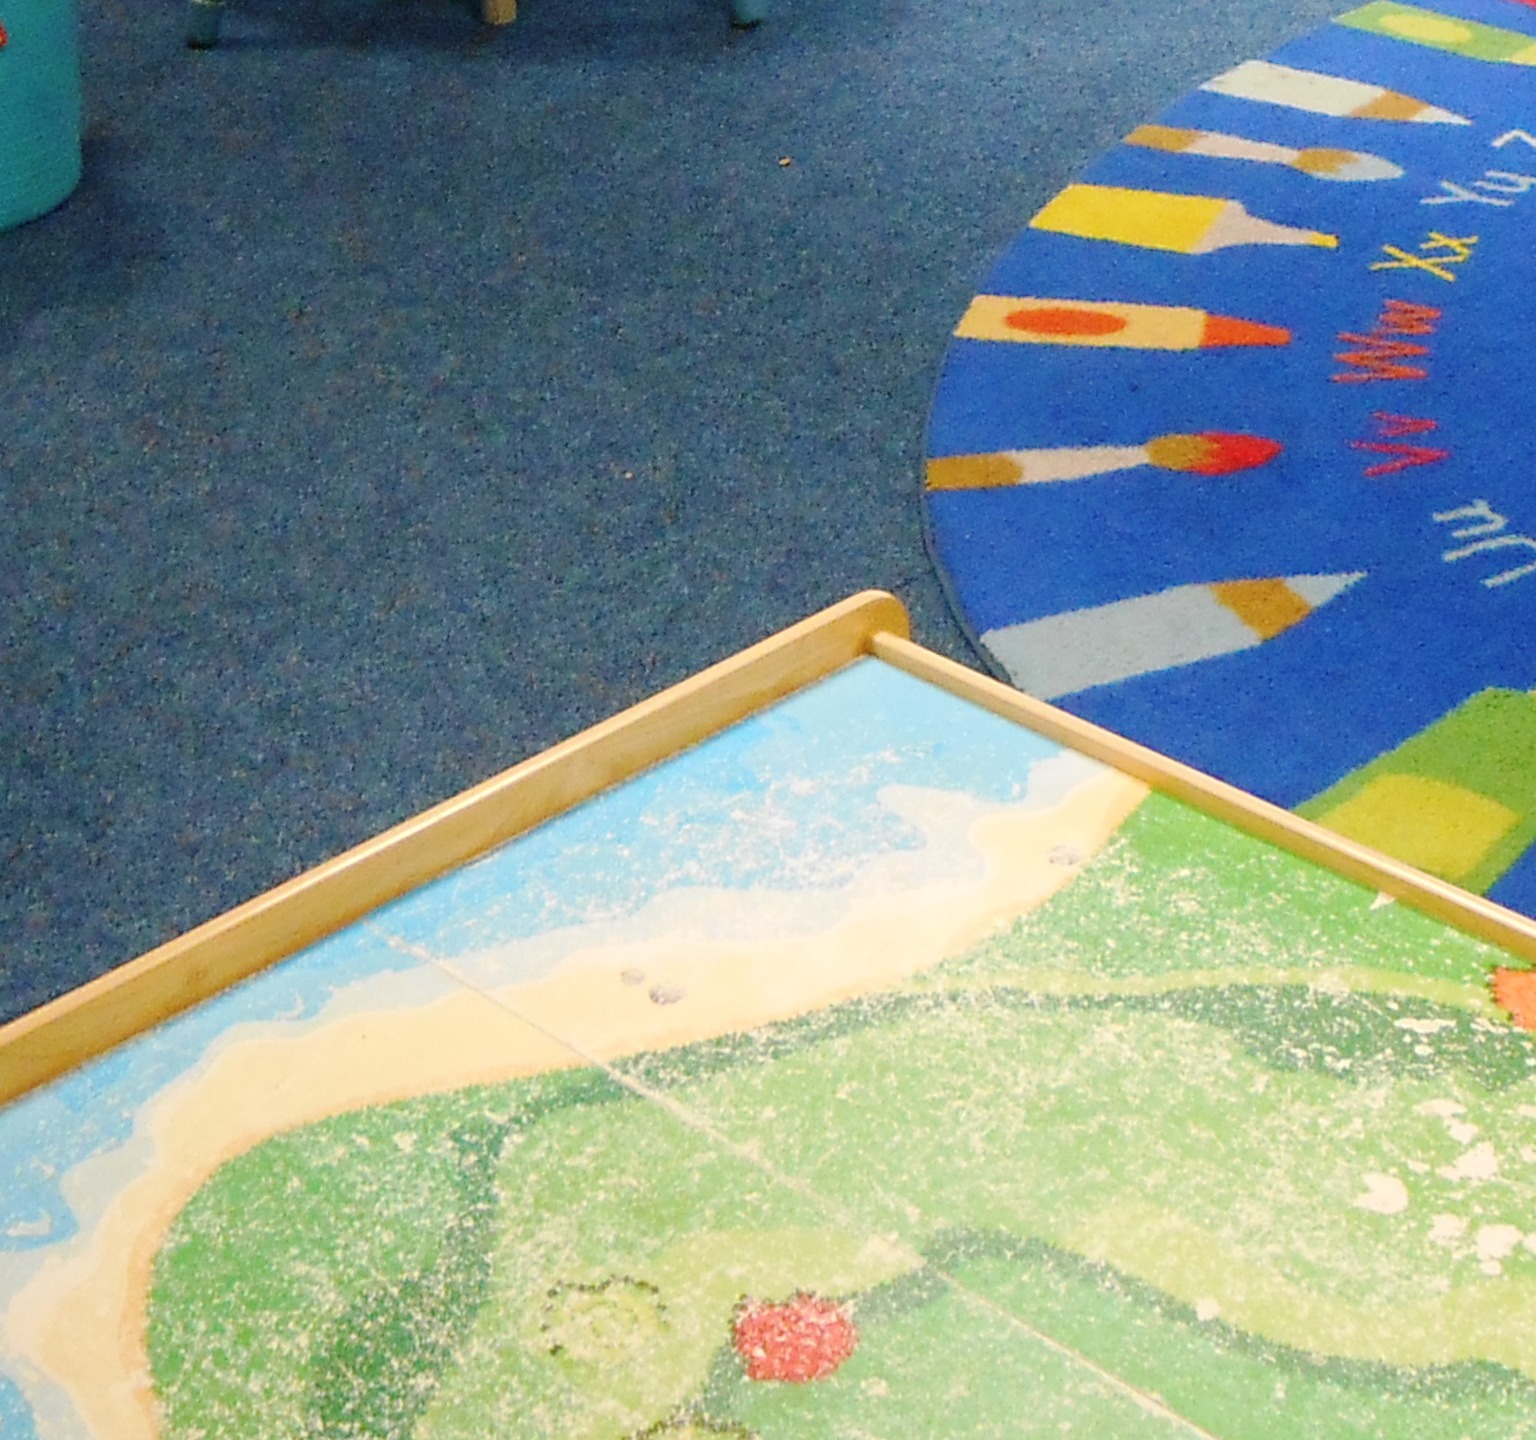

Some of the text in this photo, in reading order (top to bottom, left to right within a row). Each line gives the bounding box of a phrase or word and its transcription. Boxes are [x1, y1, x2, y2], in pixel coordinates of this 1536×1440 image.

[1372, 232, 1478, 281] Xx
[1334, 300, 1440, 381] Ww
[1353, 413, 1448, 476] Vv
